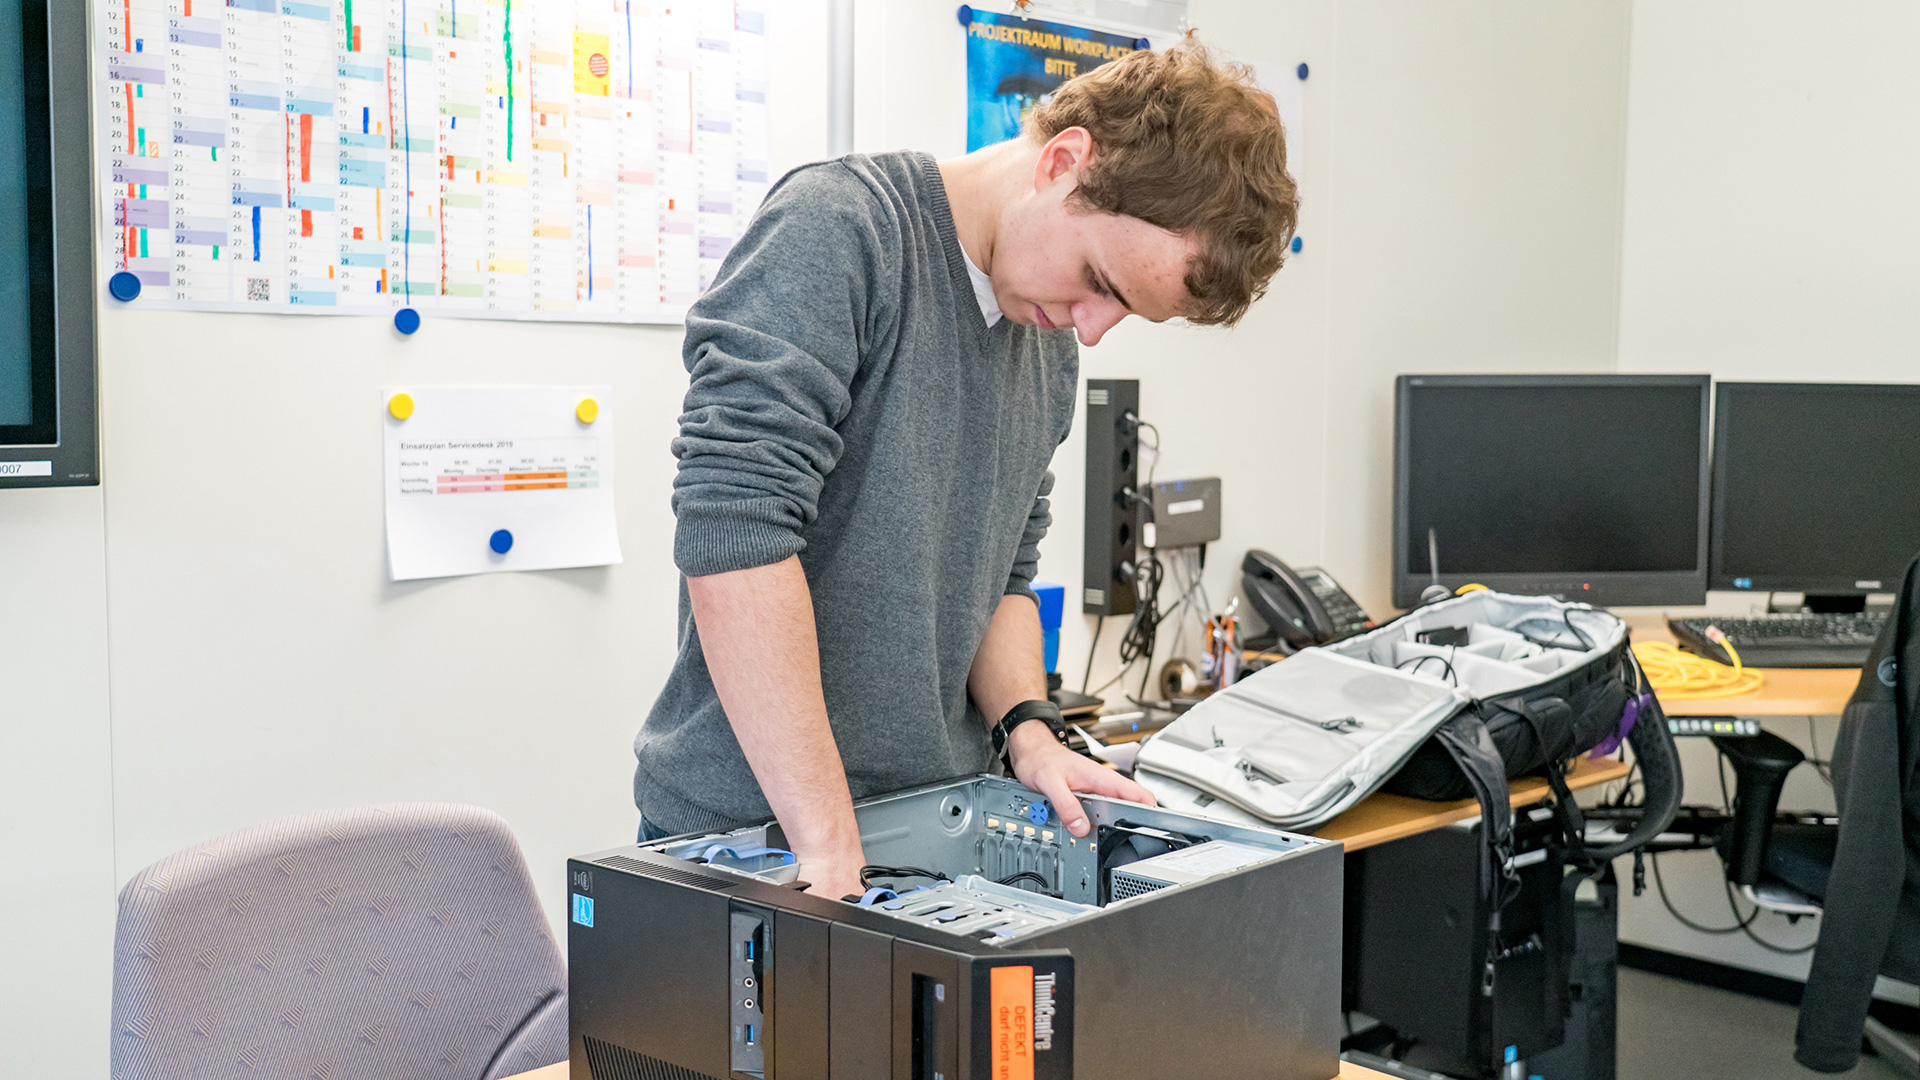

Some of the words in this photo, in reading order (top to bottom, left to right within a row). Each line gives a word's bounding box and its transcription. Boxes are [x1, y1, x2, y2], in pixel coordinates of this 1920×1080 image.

[169, 5, 177, 13] 11
[282, 6, 291, 15] 10
[108, 12, 117, 20] 12
[227, 13, 235, 21] 11
[336, 14, 344, 22] 10
[169, 19, 178, 28] 12
[283, 20, 291, 28] 11
[108, 27, 118, 35] 13
[227, 27, 236, 35] 12
[170, 34, 179, 42] 13
[968, 21, 1062, 50] PROJEKTRAUM
[109, 41, 118, 49] 14
[109, 56, 119, 64] 15
[338, 55, 345, 63] 13
[171, 63, 180, 71] 15
[285, 62, 293, 70] 14
[1044, 57, 1078, 77] BITTE
[109, 71, 120, 80] 16
[229, 70, 238, 78] 15
[172, 77, 181, 85] 16
[285, 76, 293, 84] 15
[110, 86, 120, 94] 17
[230, 84, 239, 92] 16
[173, 92, 181, 100] 17
[286, 90, 294, 98] 16
[230, 98, 239, 106] 17
[339, 96, 347, 104] 16
[111, 101, 121, 109] 18
[286, 104, 294, 112] 17
[173, 106, 182, 115] 18
[111, 115, 121, 124] 19
[174, 121, 183, 129] 19
[340, 123, 347, 131] 18
[111, 130, 122, 138] 20
[231, 127, 240, 135] 19
[173, 135, 183, 143] 20
[340, 137, 348, 145] 19
[174, 150, 183, 158] 21
[340, 150, 348, 158] 20
[113, 159, 123, 167] 22
[174, 164, 184, 172] 22
[113, 174, 123, 182] 23
[340, 177, 348, 185] 22
[175, 179, 184, 187] 23
[232, 183, 241, 191] 23
[233, 196, 242, 204] 24
[115, 203, 125, 211] 25
[175, 207, 184, 215] 25
[232, 211, 242, 219] 25
[115, 218, 125, 226] 26
[175, 221, 185, 229] 26
[233, 225, 242, 233] 26
[288, 228, 297, 236] 26
[115, 232, 125, 240] 27
[176, 235, 185, 243] 27
[115, 247, 125, 255] 28
[176, 250, 186, 258] 28
[176, 264, 186, 272] 29
[341, 271, 350, 279] 29
[176, 278, 186, 286] 30
[290, 282, 298, 290] 30
[176, 292, 185, 300] 31
[290, 296, 298, 304] 31
[400, 442, 446, 450] Einsatzplan
[448, 441, 494, 449] Servicedesk
[0, 464, 22, 474] 007
[1034, 971, 1056, 1050] ThinkCentre
[999, 1006, 1011, 1030] darf
[1014, 1005, 1027, 1058] DEFEKT
[999, 1033, 1011, 1062] nicht
